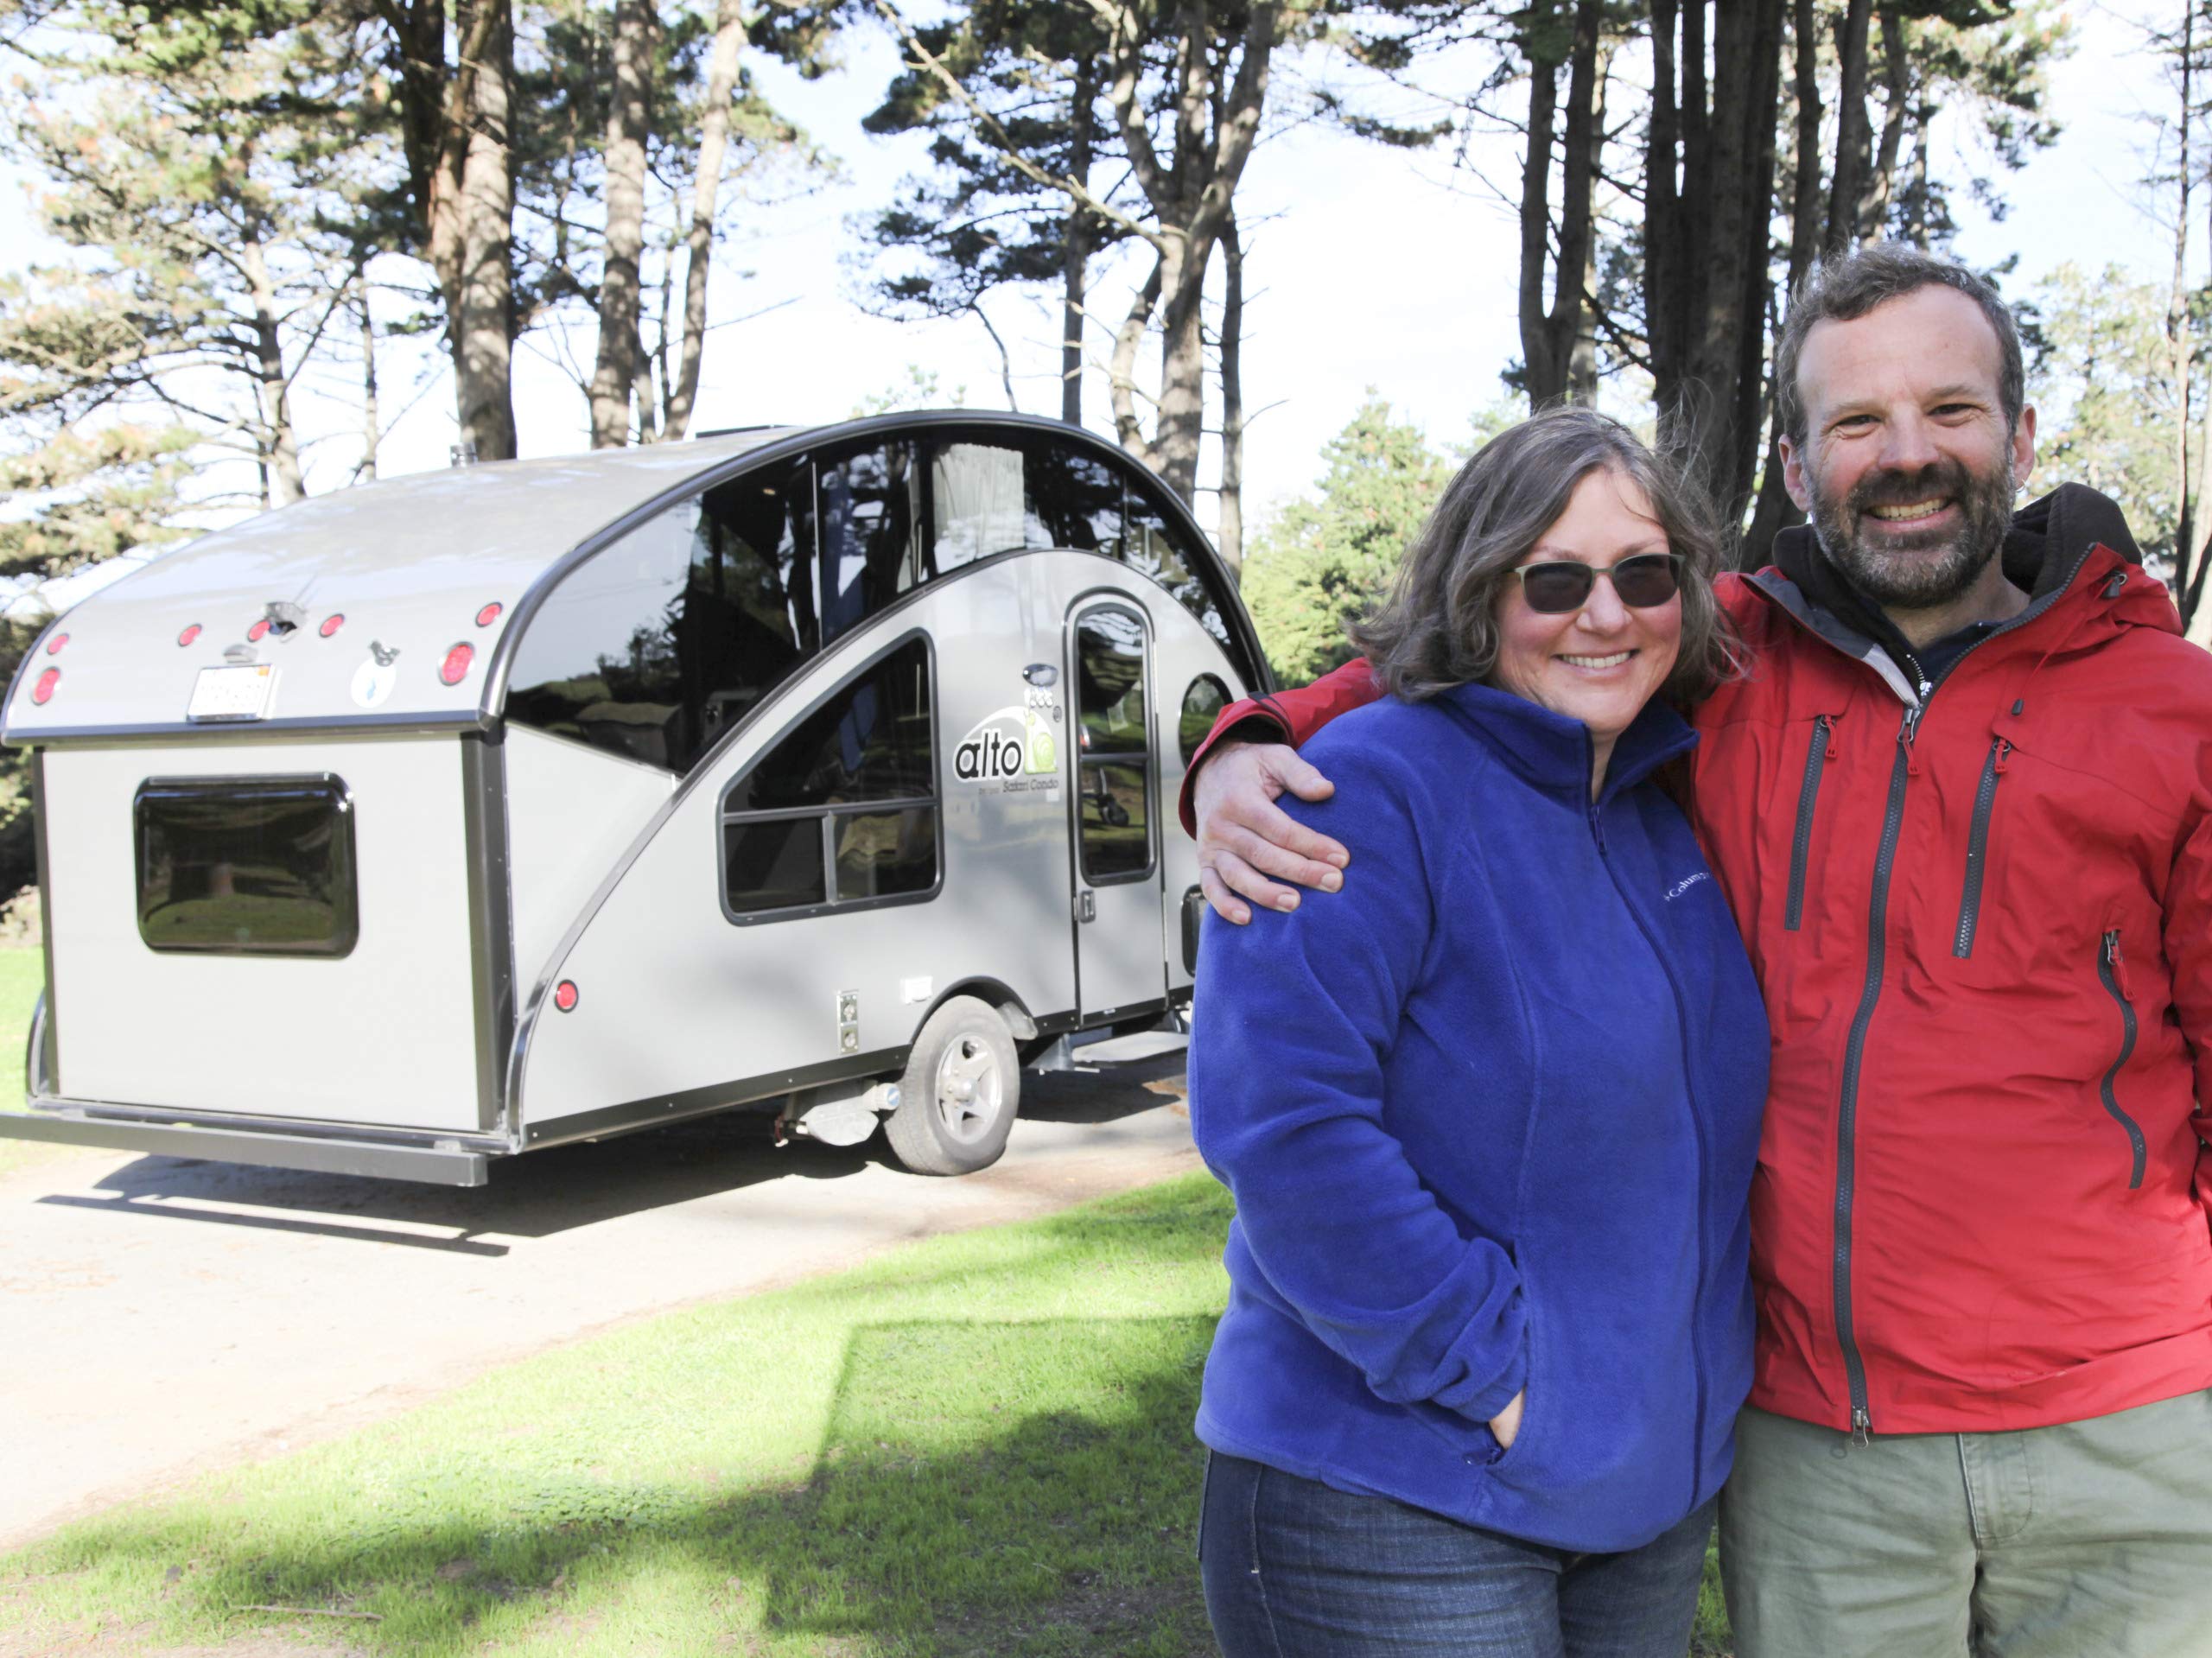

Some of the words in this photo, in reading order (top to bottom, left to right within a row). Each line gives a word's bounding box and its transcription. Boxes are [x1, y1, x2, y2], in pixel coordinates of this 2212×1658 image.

[955, 732, 1022, 779] alto
[1030, 779, 1058, 790] Condo
[1669, 873, 1709, 897] Colum
